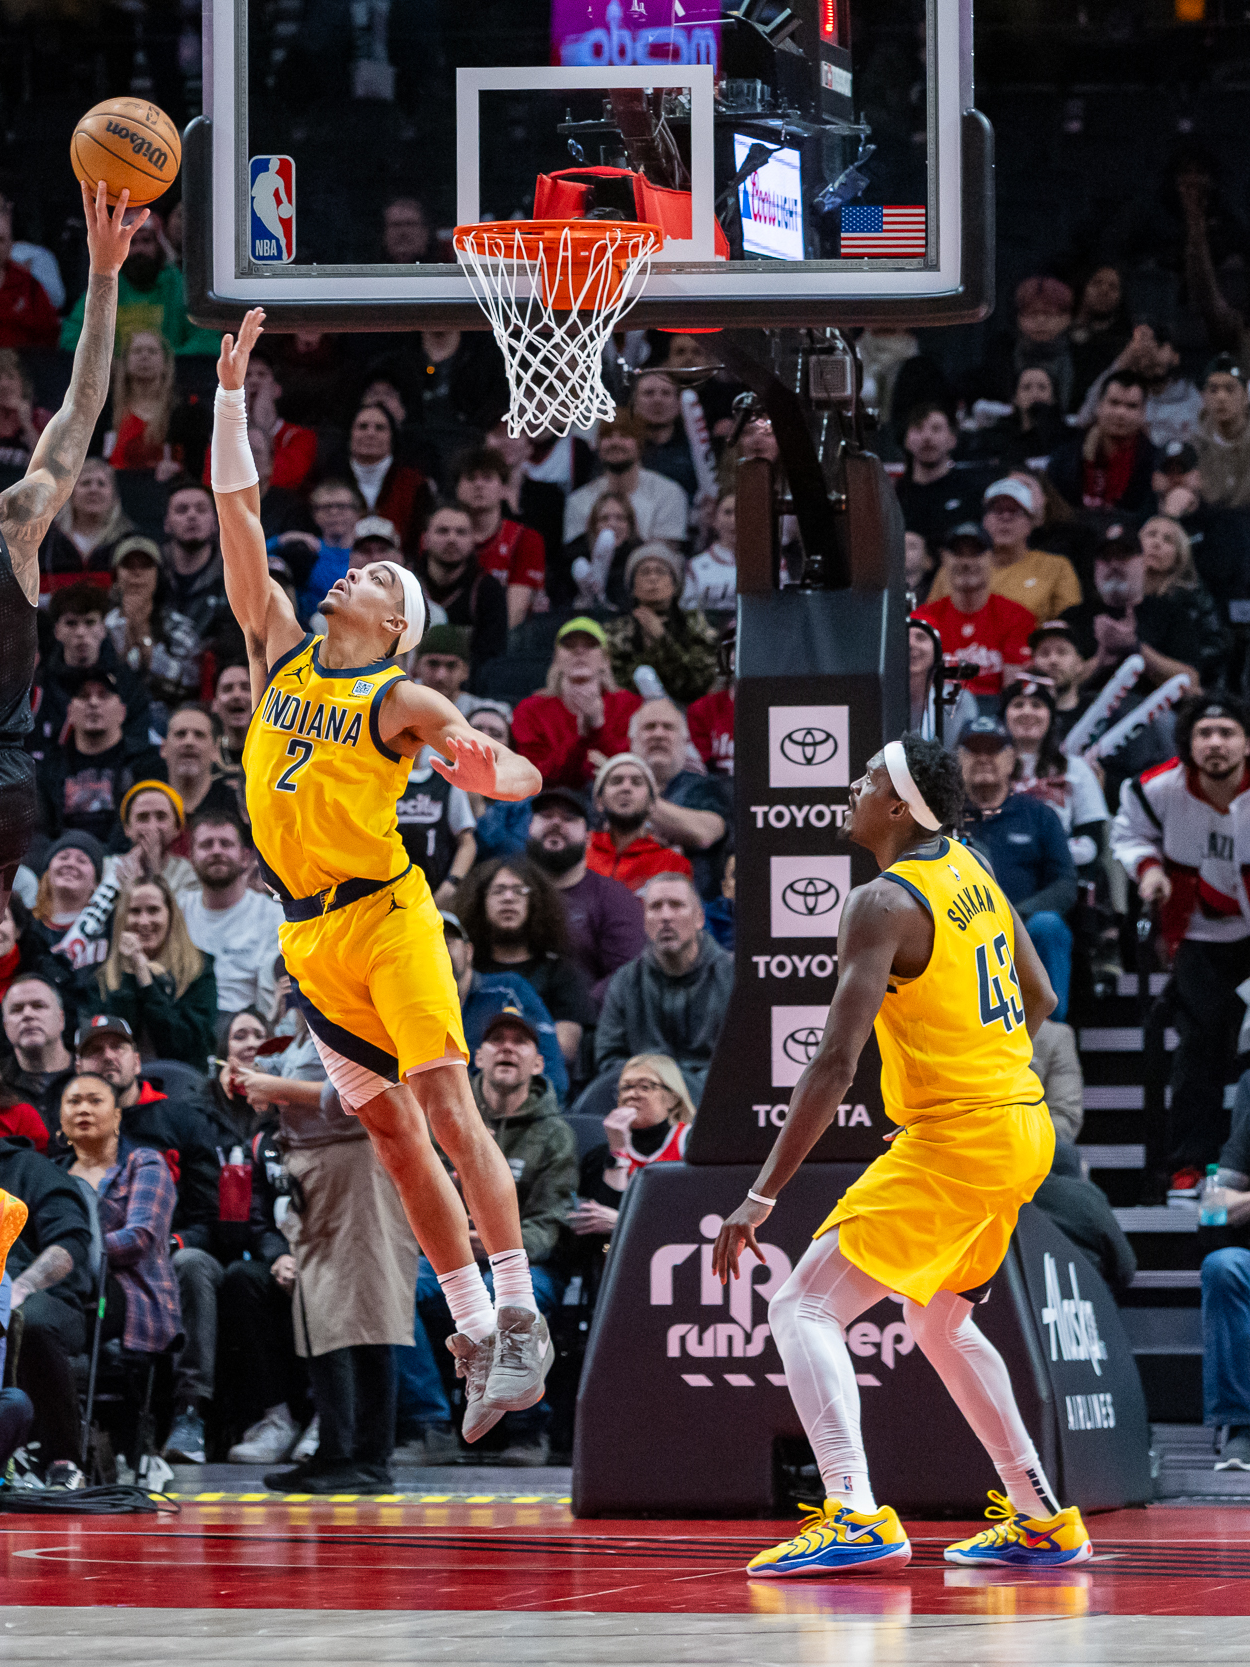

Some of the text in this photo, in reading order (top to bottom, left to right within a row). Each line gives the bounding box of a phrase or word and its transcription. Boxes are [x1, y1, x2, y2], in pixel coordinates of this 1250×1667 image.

[105, 120, 168, 172] Wilson
[255, 239, 278, 257] NBA
[261, 686, 363, 748] INDIANA
[274, 737, 314, 793] 2
[750, 804, 850, 828] TOYOT
[947, 884, 996, 931] SIAKAM
[752, 954, 838, 978] TOYO
[975, 931, 1026, 1034] 43
[752, 1104, 872, 1127] TOTA
[650, 1213, 792, 1334] rip
[842, 1321, 916, 1370] ep
[1065, 1392, 1116, 1430] AIRLINES
